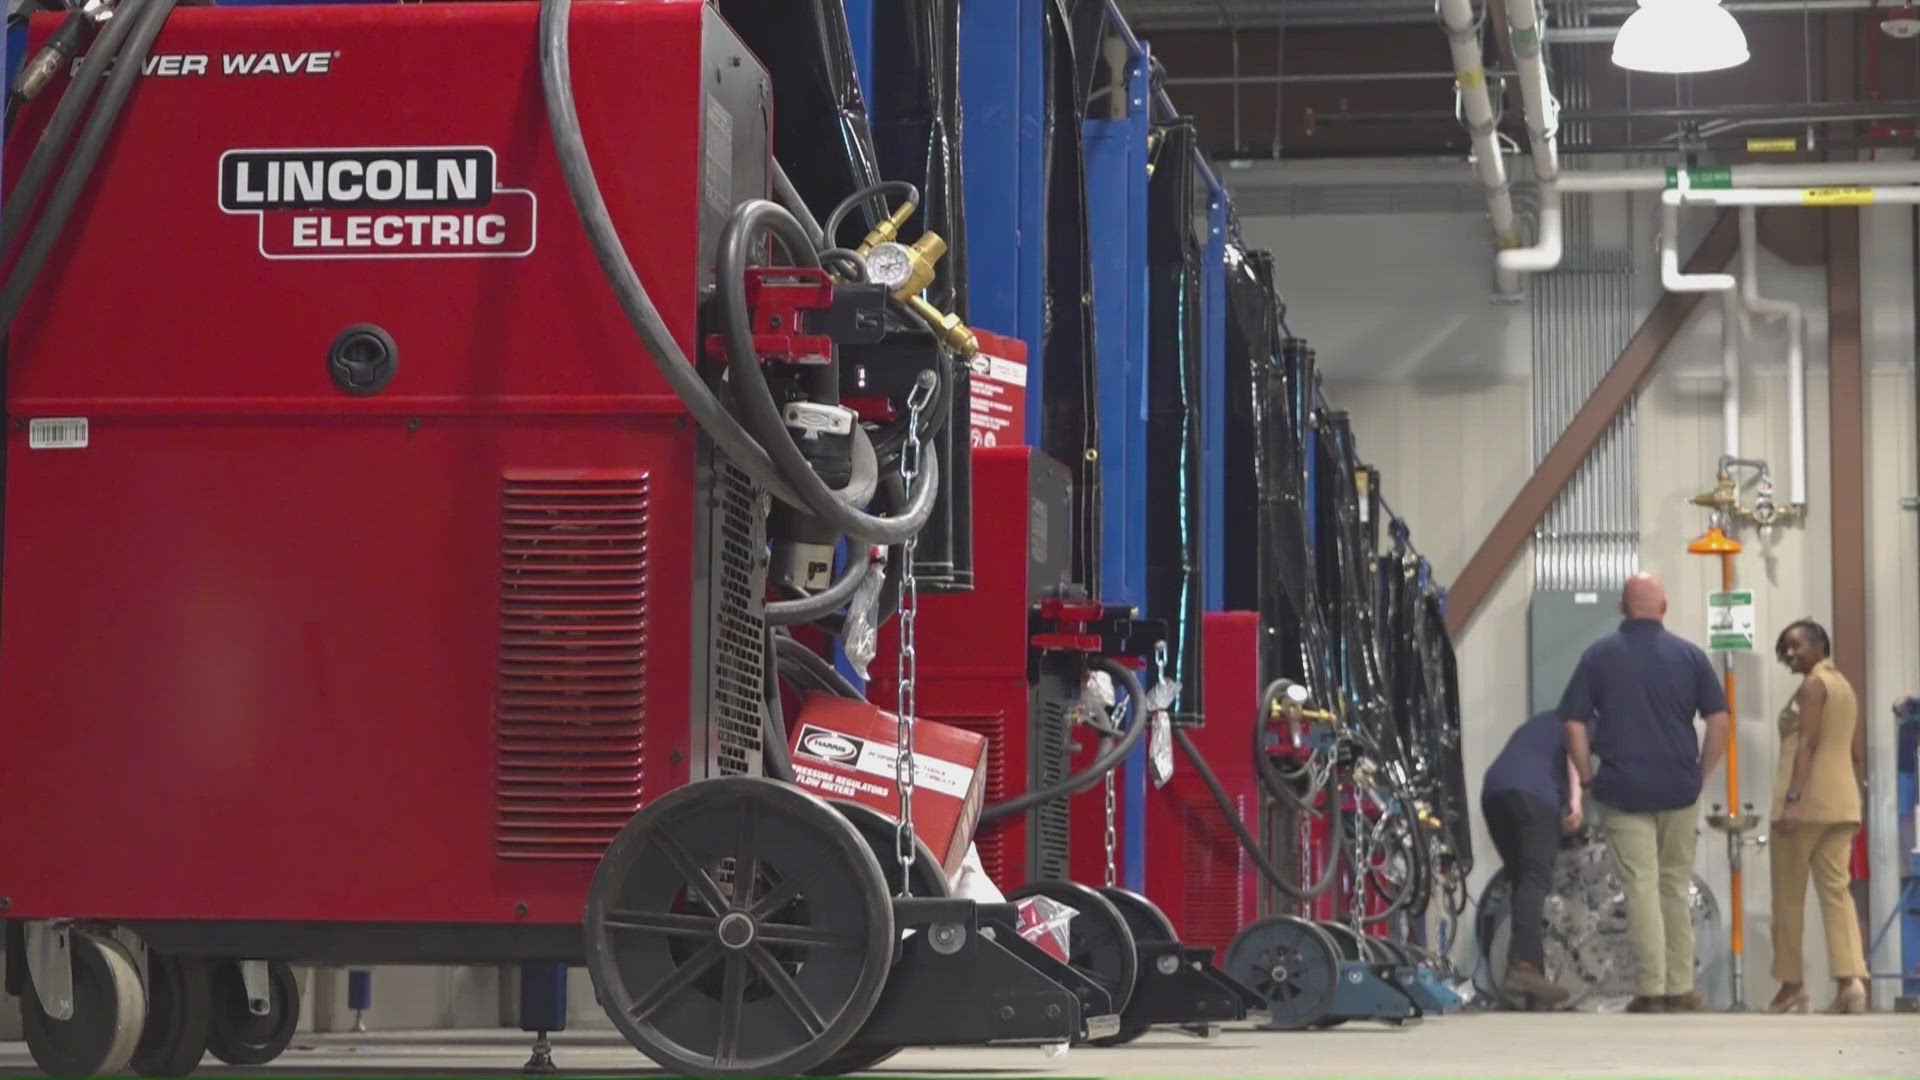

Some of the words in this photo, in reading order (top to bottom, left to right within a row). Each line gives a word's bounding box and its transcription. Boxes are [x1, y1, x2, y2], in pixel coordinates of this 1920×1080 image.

[236, 159, 478, 203] LINCOLN
[292, 214, 507, 248] ELECTRIC
[814, 740, 847, 753] HARRIS
[791, 763, 835, 783] PRESSURE
[835, 774, 889, 797] REGULATORS
[795, 774, 821, 788] FLOW
[820, 780, 856, 797] METERS
